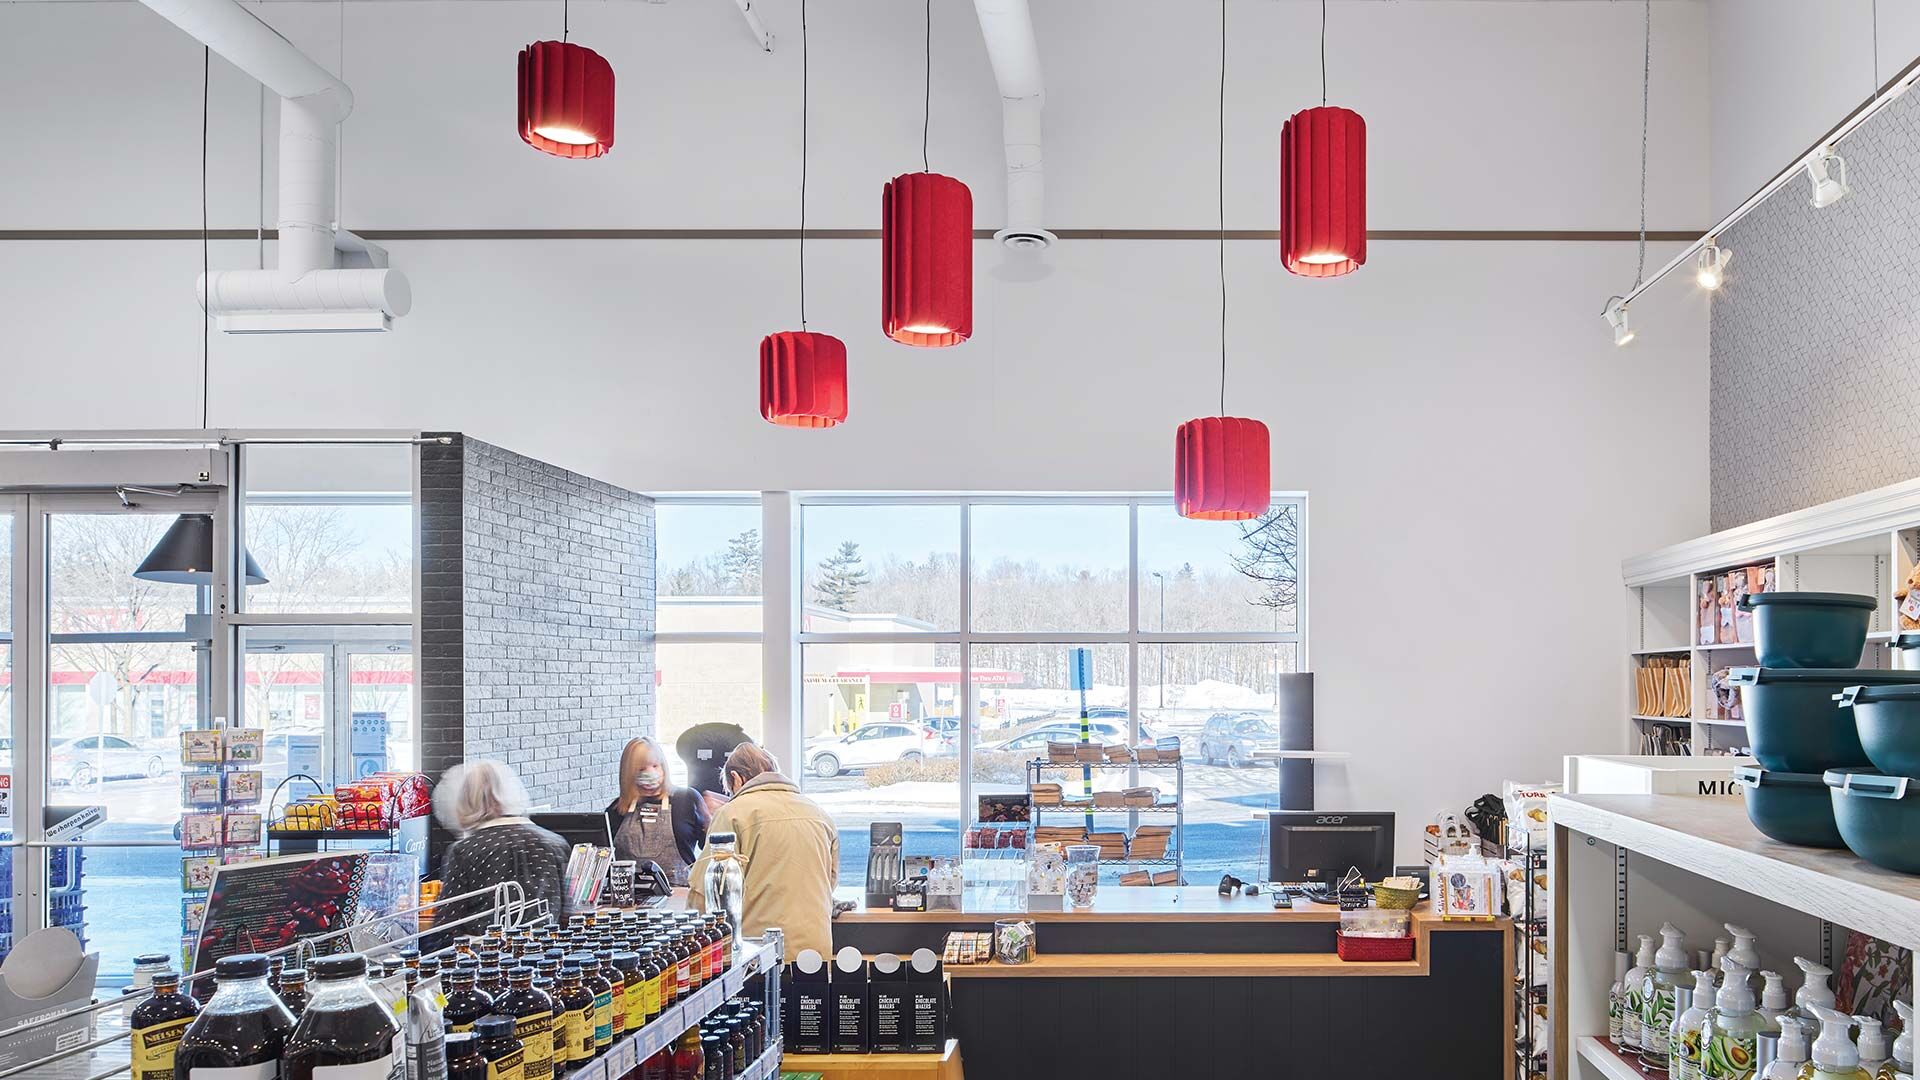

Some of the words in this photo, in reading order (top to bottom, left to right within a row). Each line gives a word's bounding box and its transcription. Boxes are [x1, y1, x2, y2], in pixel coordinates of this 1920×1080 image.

[46, 829, 58, 837] We
[57, 815, 82, 832] sharpen
[1315, 815, 1348, 824] acer
